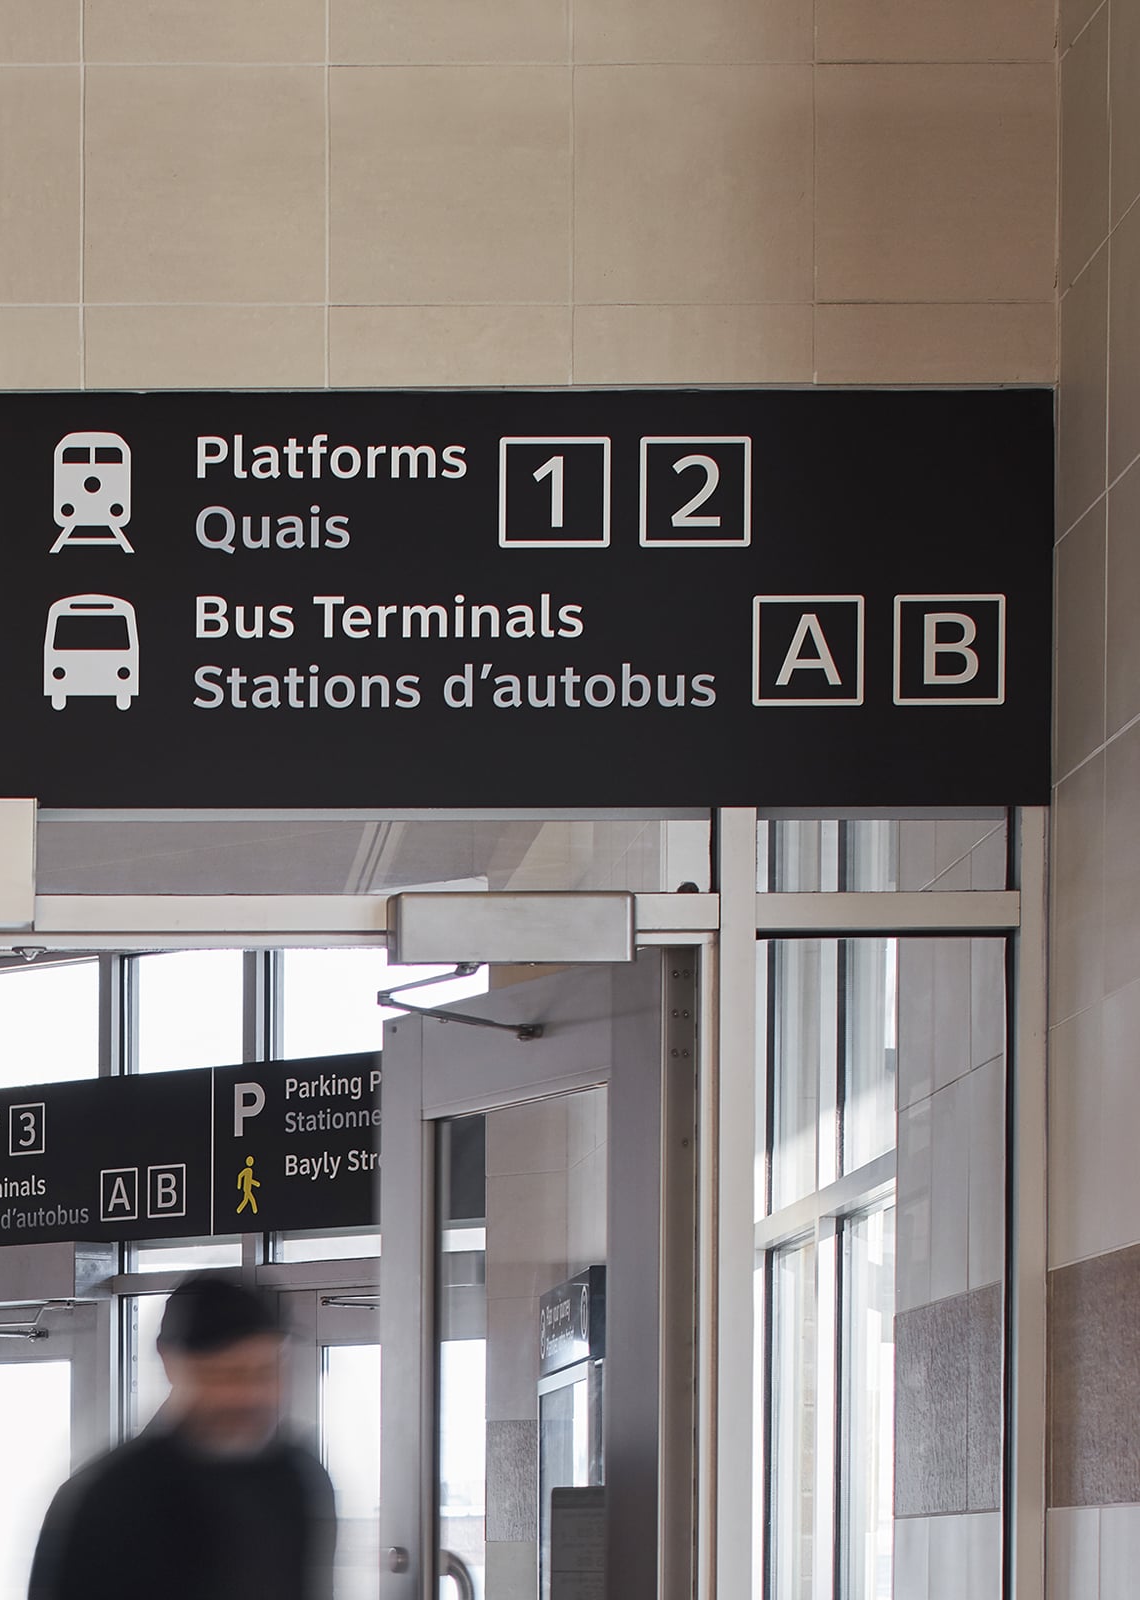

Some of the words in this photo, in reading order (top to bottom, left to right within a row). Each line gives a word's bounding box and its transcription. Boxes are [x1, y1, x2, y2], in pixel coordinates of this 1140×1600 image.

[196, 433, 467, 479] Platforms
[532, 455, 564, 528] 1
[670, 454, 721, 528] 2
[195, 504, 351, 555] Quais
[195, 595, 295, 639] Bus
[312, 593, 584, 639] Terminals
[775, 613, 842, 686] A
[923, 612, 979, 685] B
[193, 664, 421, 709] Stations
[443, 662, 717, 708] d'autobus
[233, 1082, 266, 1138] P
[285, 1074, 362, 1100] Parking
[18, 1112, 38, 1147] 3
[285, 1151, 342, 1181] Bayly
[107, 1176, 131, 1212] A
[156, 1174, 178, 1209] B
[0, 1203, 90, 1230] d'autobus
